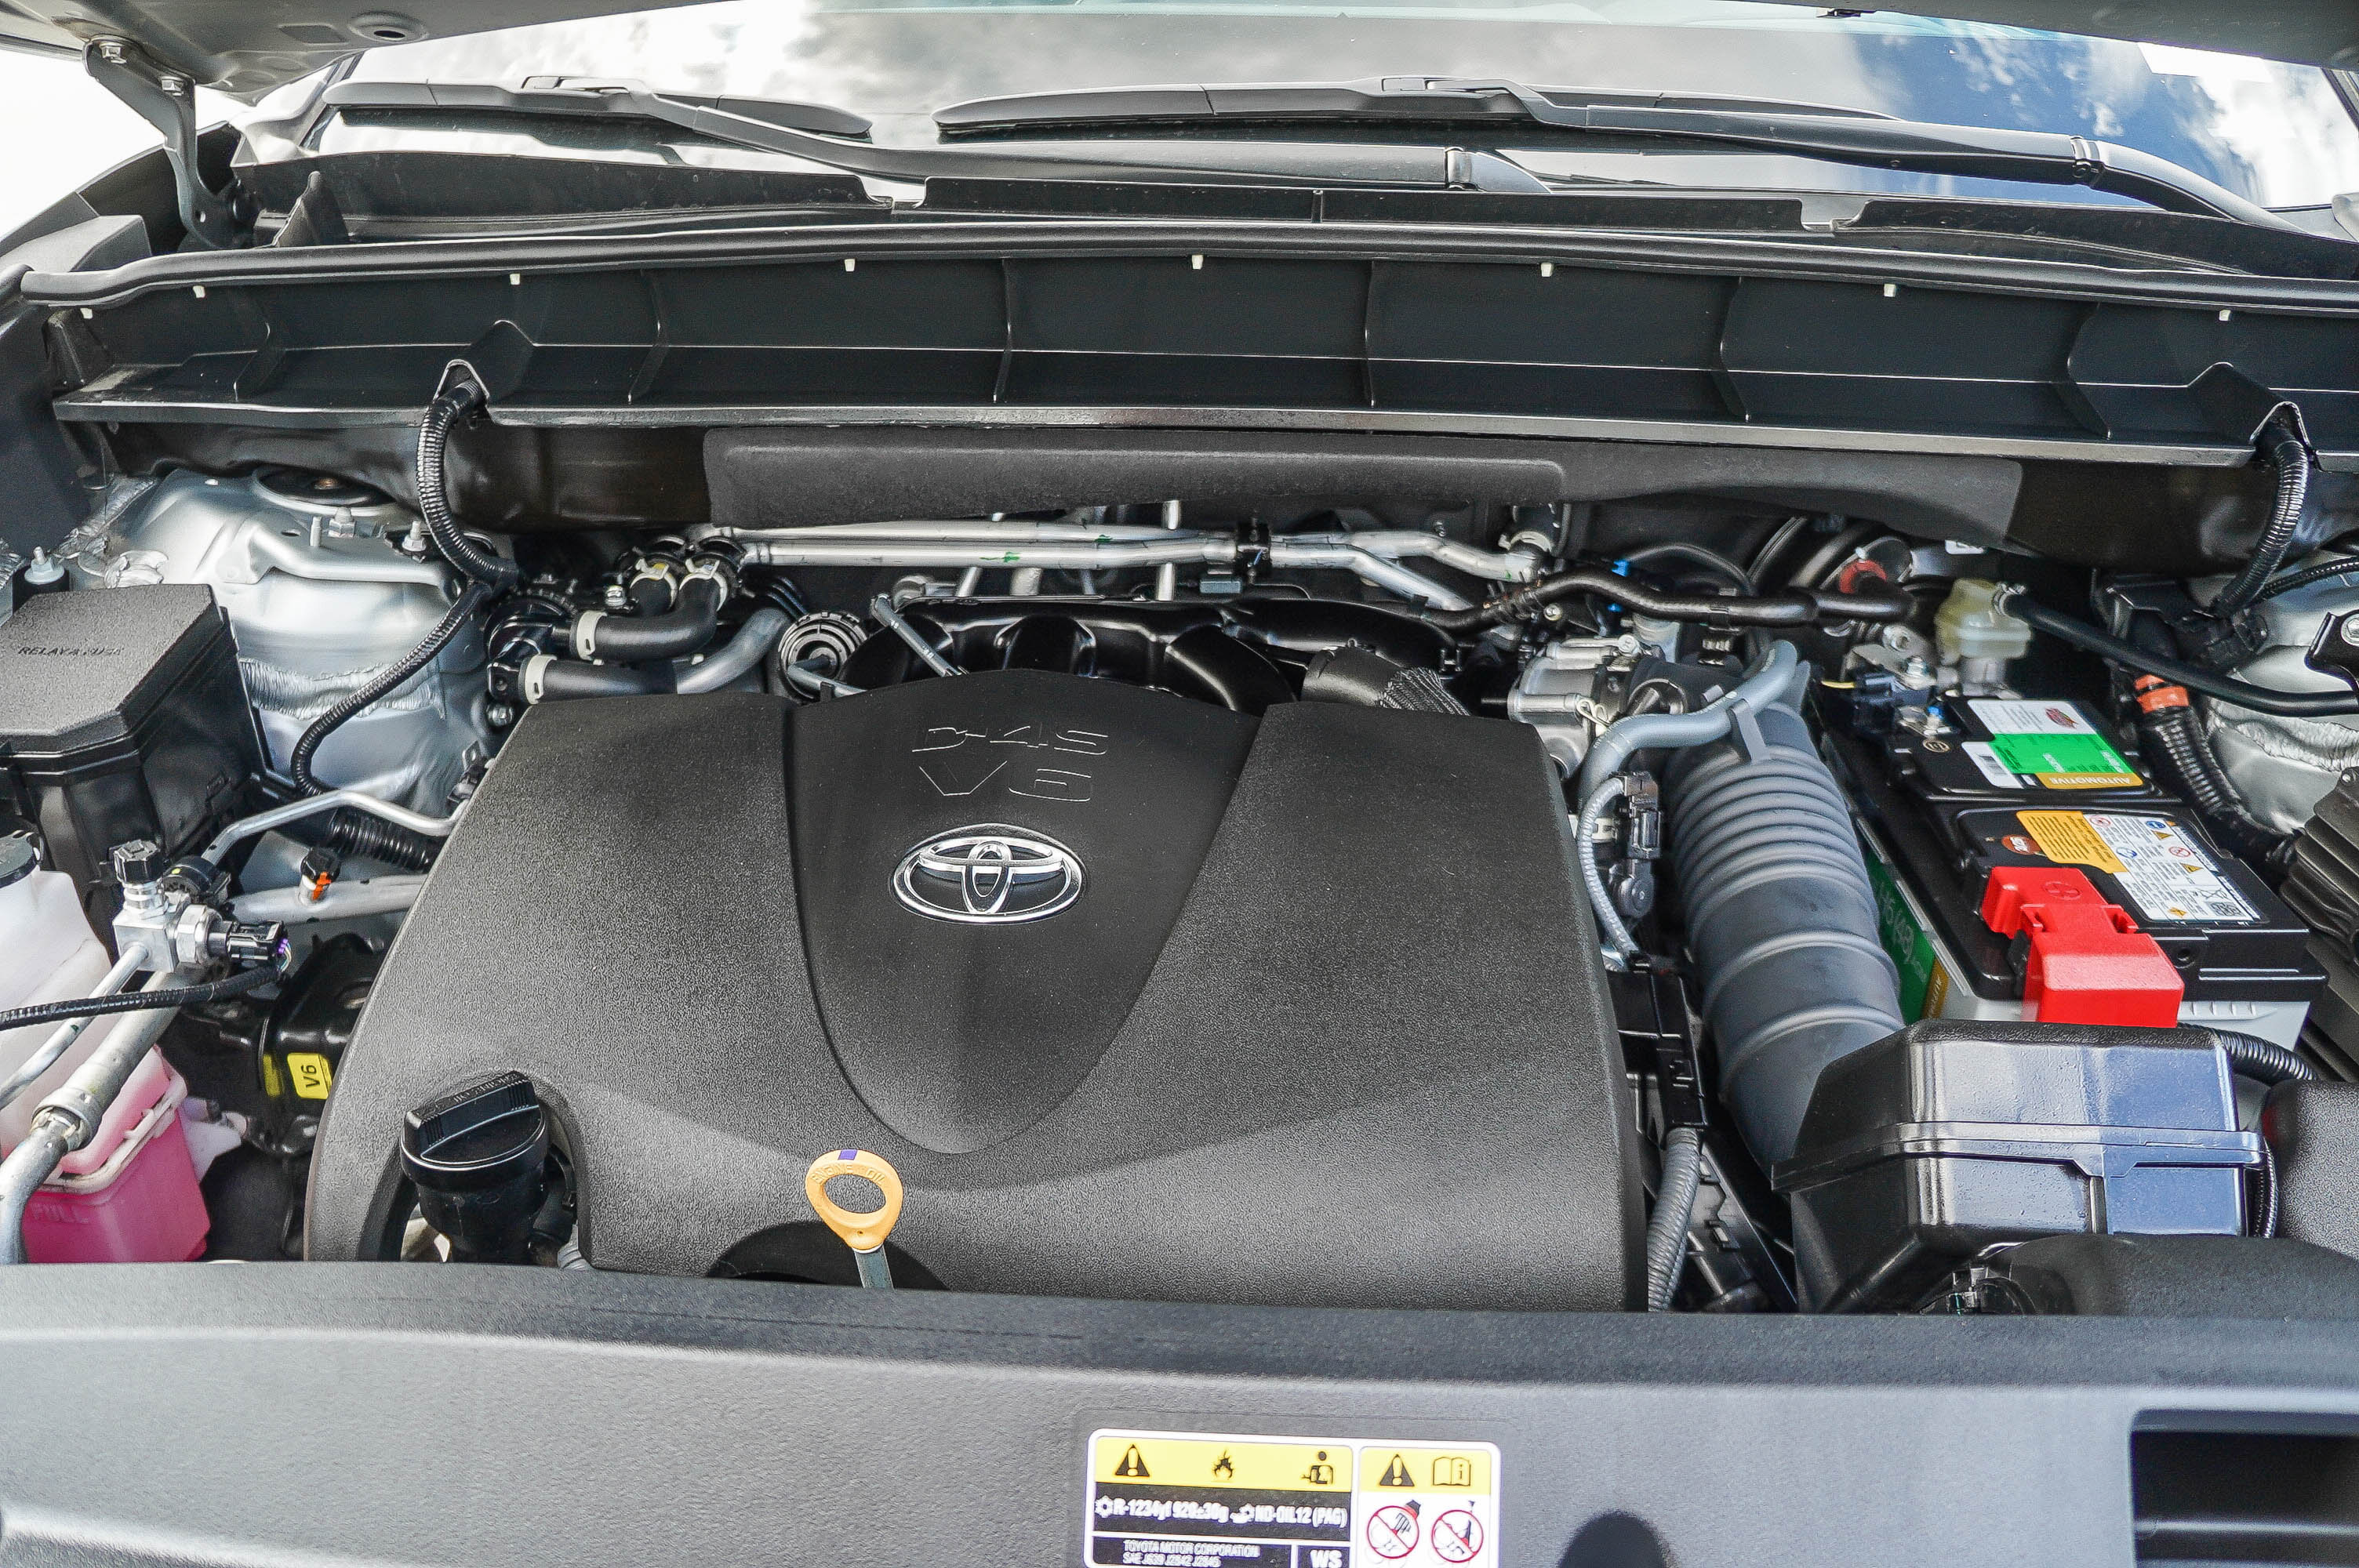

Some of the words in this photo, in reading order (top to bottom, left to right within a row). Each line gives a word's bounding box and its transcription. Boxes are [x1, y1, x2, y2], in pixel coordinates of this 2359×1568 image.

[918, 760, 1092, 803] V6
[2048, 776, 2132, 786] AUTOMOTIVE
[300, 1065, 321, 1088] V6
[812, 1163, 853, 1184] ENGINE
[867, 1168, 885, 1185] OIL
[1123, 1539, 1160, 1553] TOYOTA
[1159, 1541, 1194, 1554] MOTOR
[1310, 1549, 1343, 1568] WS
